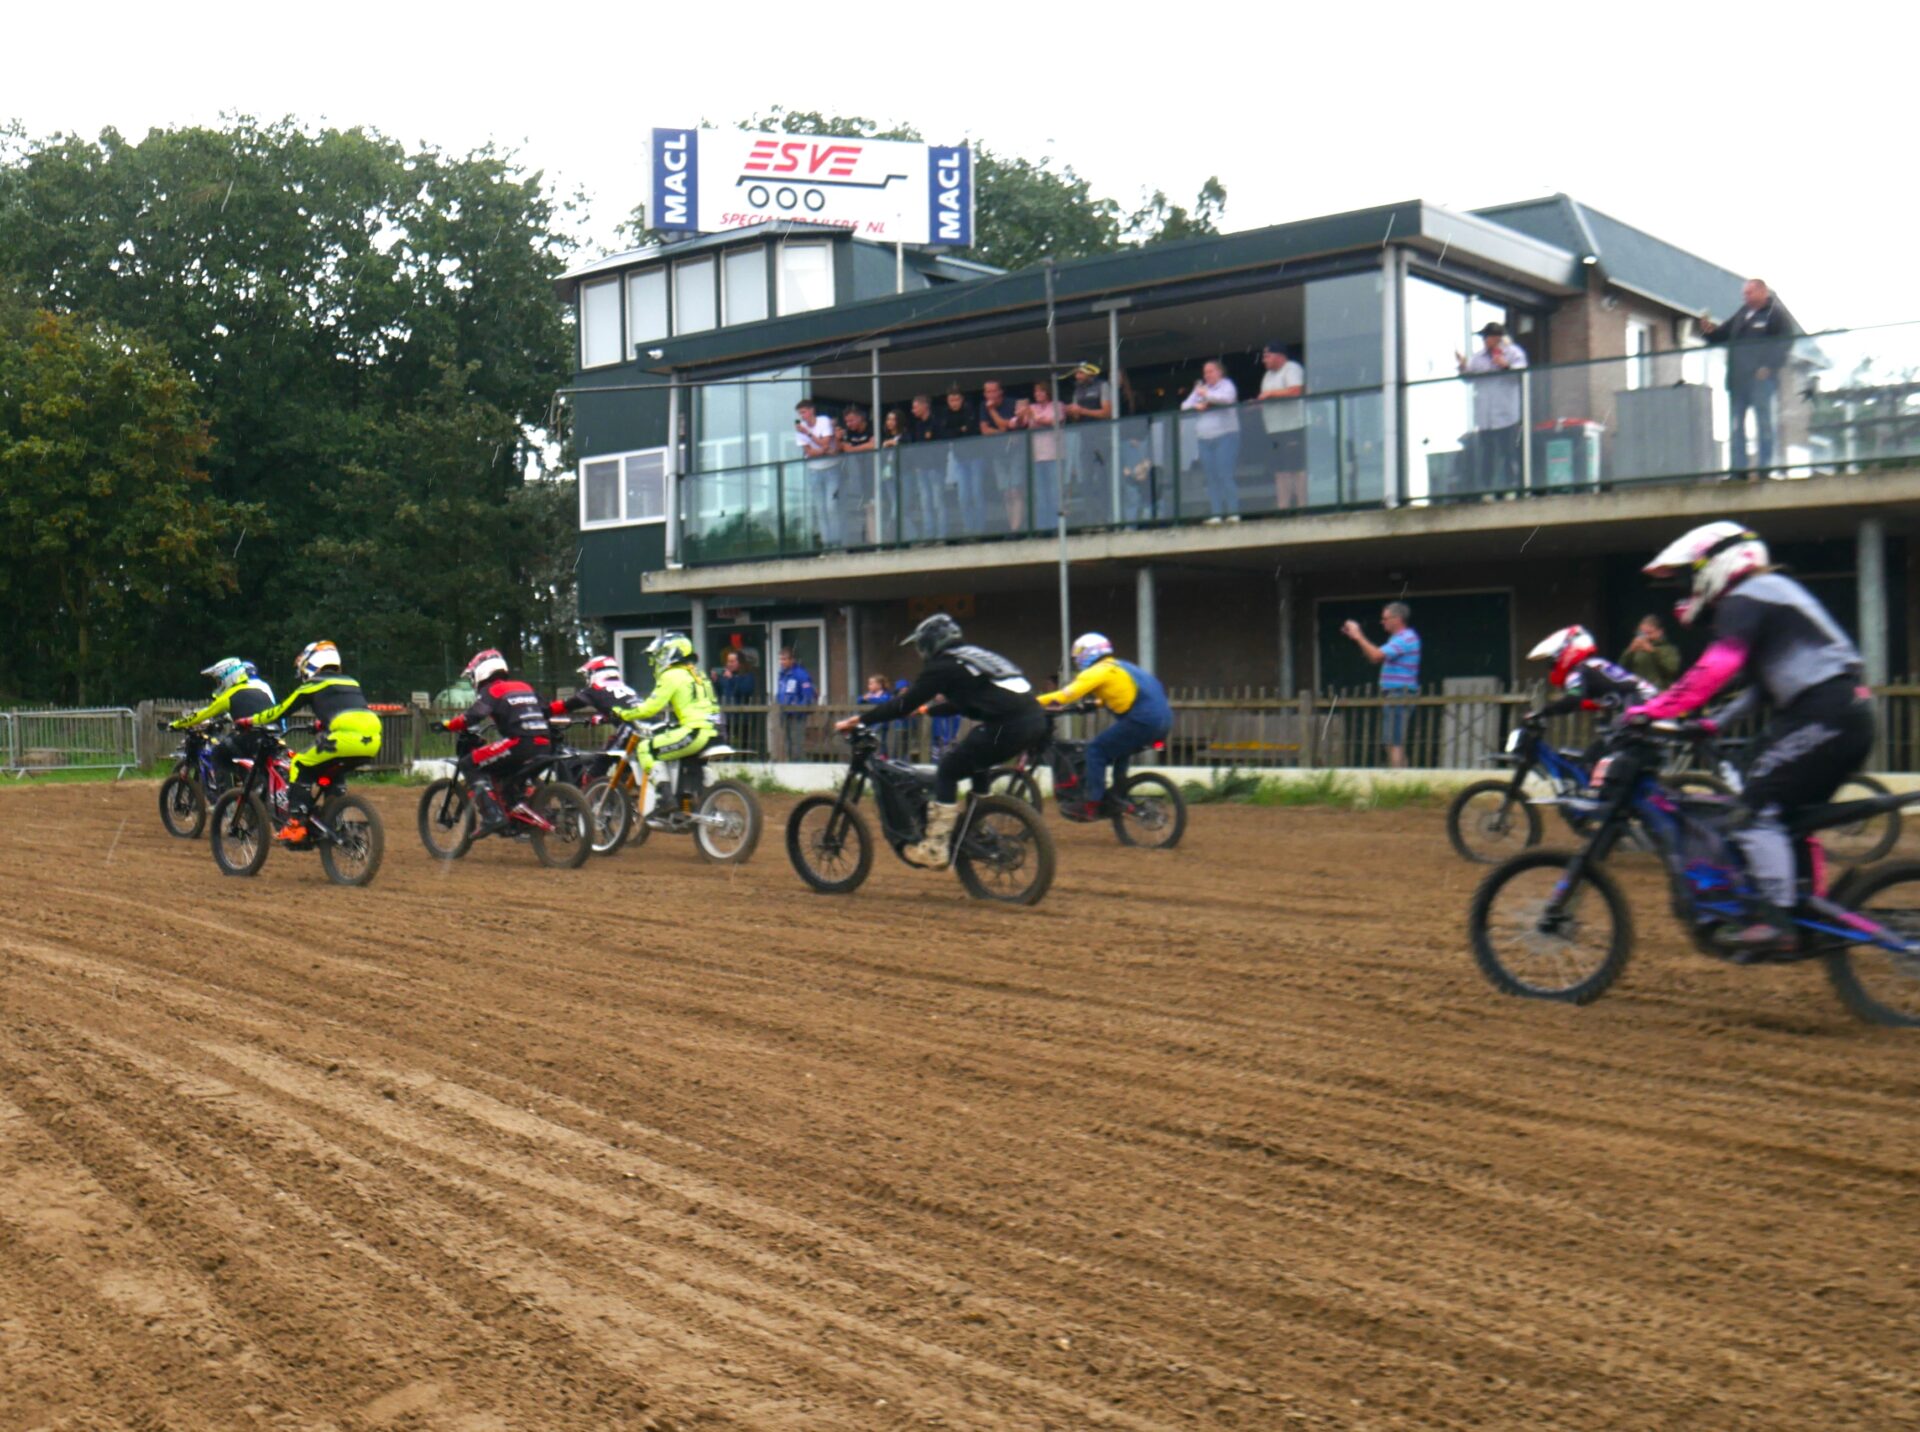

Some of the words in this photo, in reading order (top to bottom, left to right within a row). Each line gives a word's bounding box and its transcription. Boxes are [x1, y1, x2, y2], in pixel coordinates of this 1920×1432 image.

[664, 133, 687, 224] MACL
[744, 140, 863, 176] ESVE
[720, 212, 780, 228] SPECI
[865, 221, 885, 233] NL
[938, 152, 961, 240] MACL
